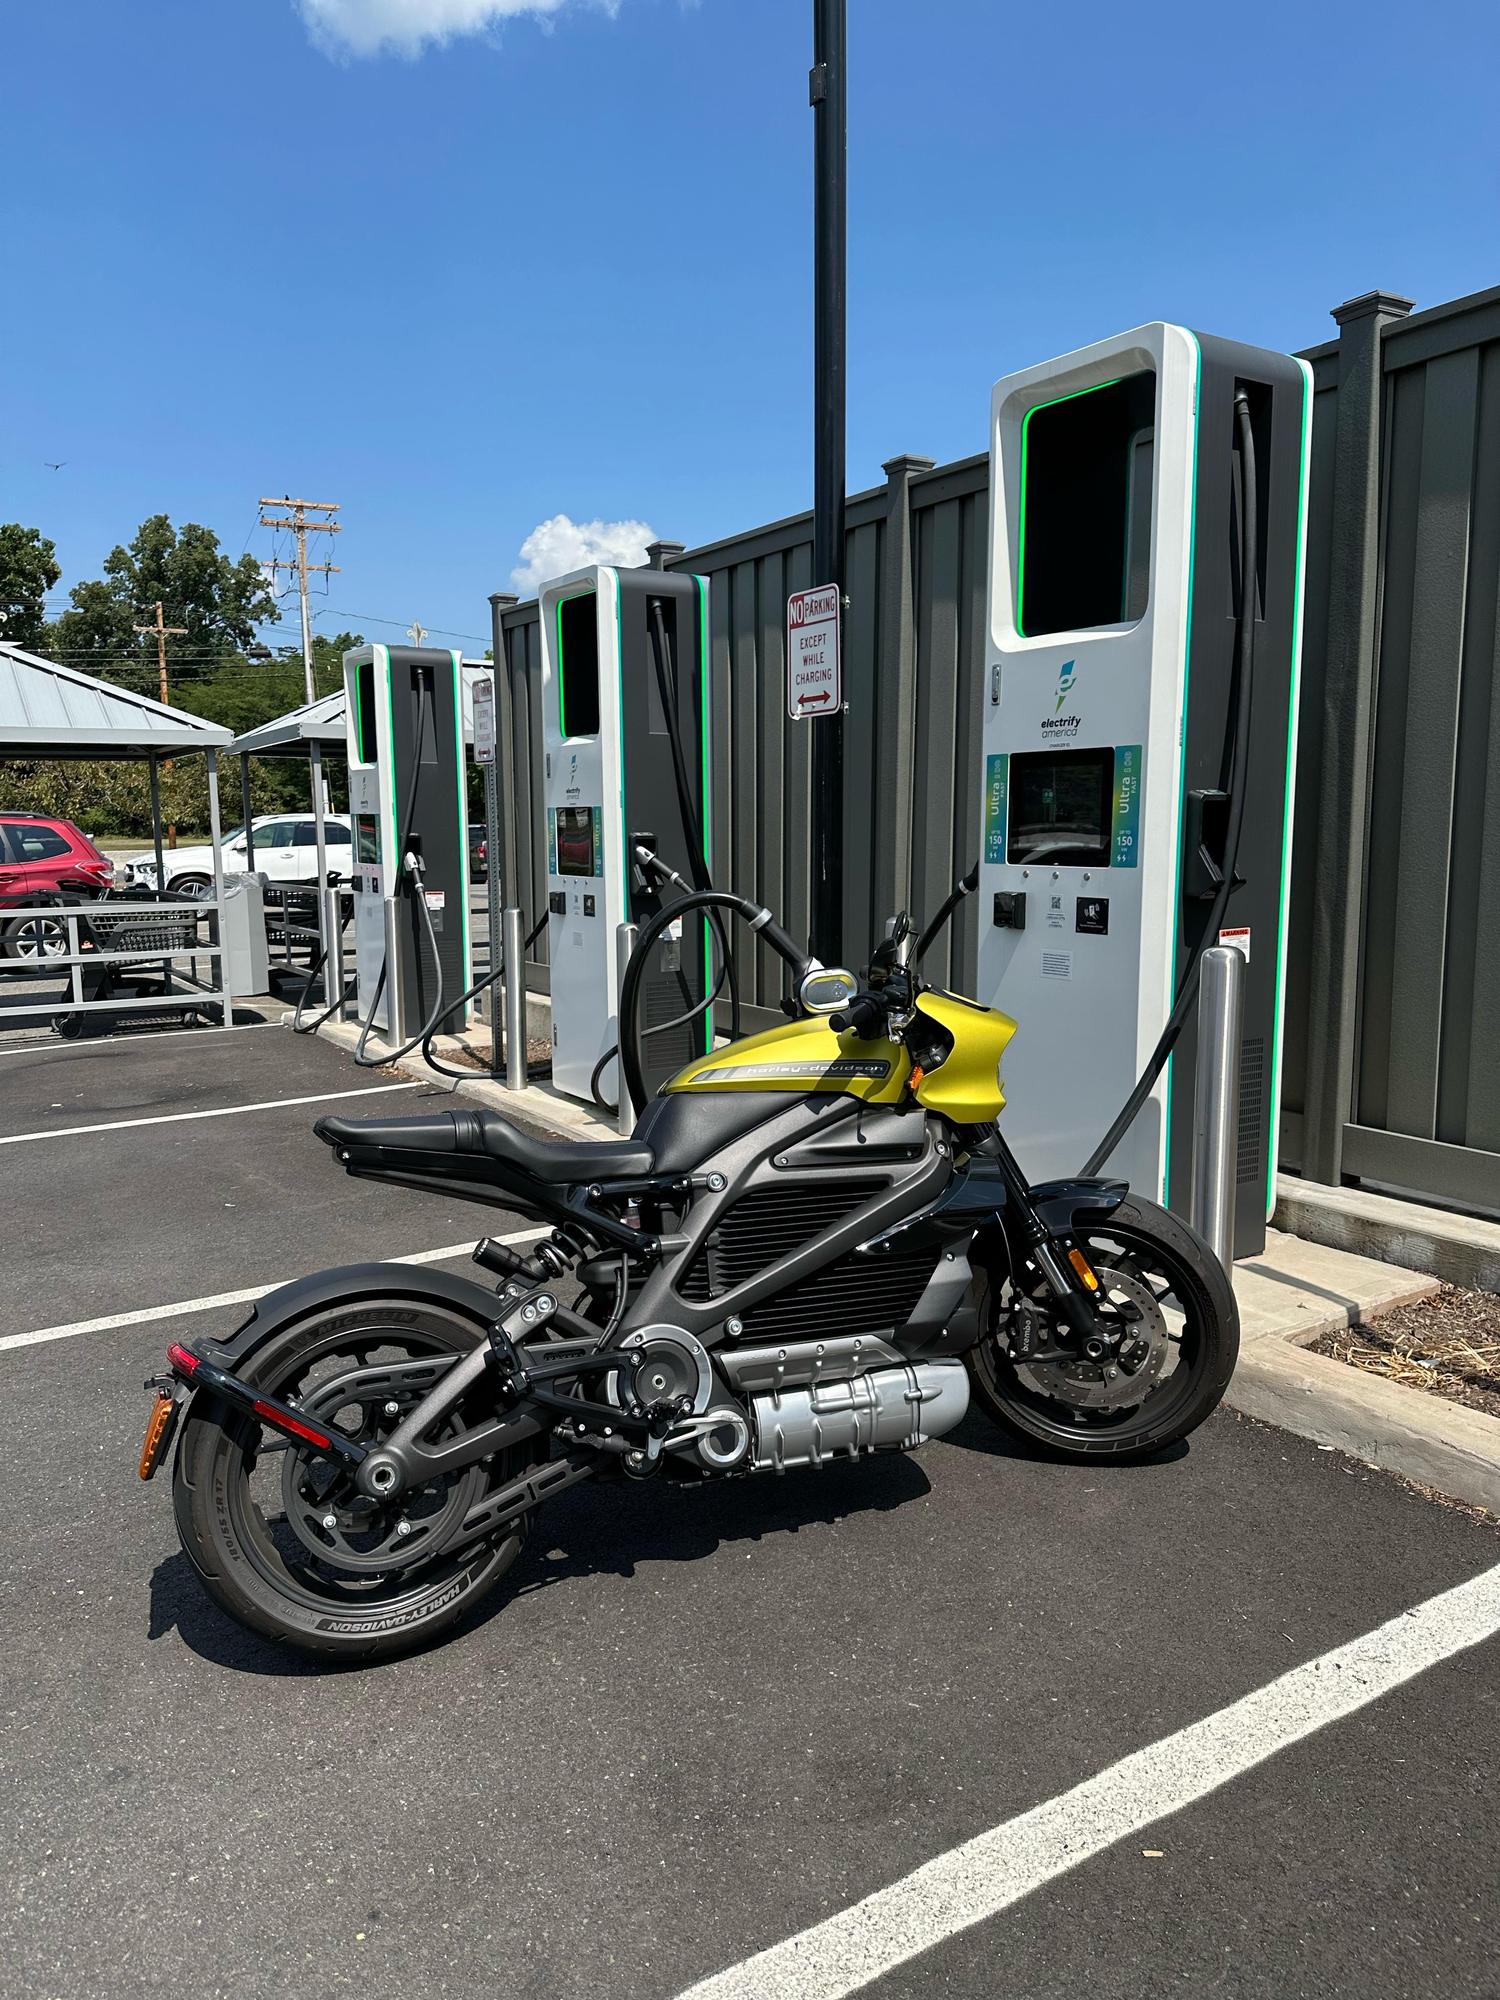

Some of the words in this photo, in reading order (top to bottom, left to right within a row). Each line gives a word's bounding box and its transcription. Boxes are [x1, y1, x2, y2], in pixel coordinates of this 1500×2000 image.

[790, 600, 804, 625] NO
[804, 595, 835, 618] PARKING
[800, 633, 827, 650] EXCEPT
[802, 651, 825, 667] WHILE
[795, 668, 832, 686] CHARGING
[1041, 716, 1081, 728] electrify
[1042, 729, 1077, 739] america
[990, 782, 1000, 816] Ultra
[1119, 777, 1131, 814] Ultra
[989, 835, 1002, 845] 150
[1117, 836, 1133, 846] 150
[747, 1064, 883, 1074] harley-davidson
[318, 1311, 413, 1335] MICHELIN
[1021, 1320, 1031, 1352] brembo
[216, 1478, 223, 1492] 17
[216, 1496, 224, 1514] ZR
[219, 1519, 241, 1562] 180/55
[328, 1584, 460, 1632] HARLEY-DAVIDSON
